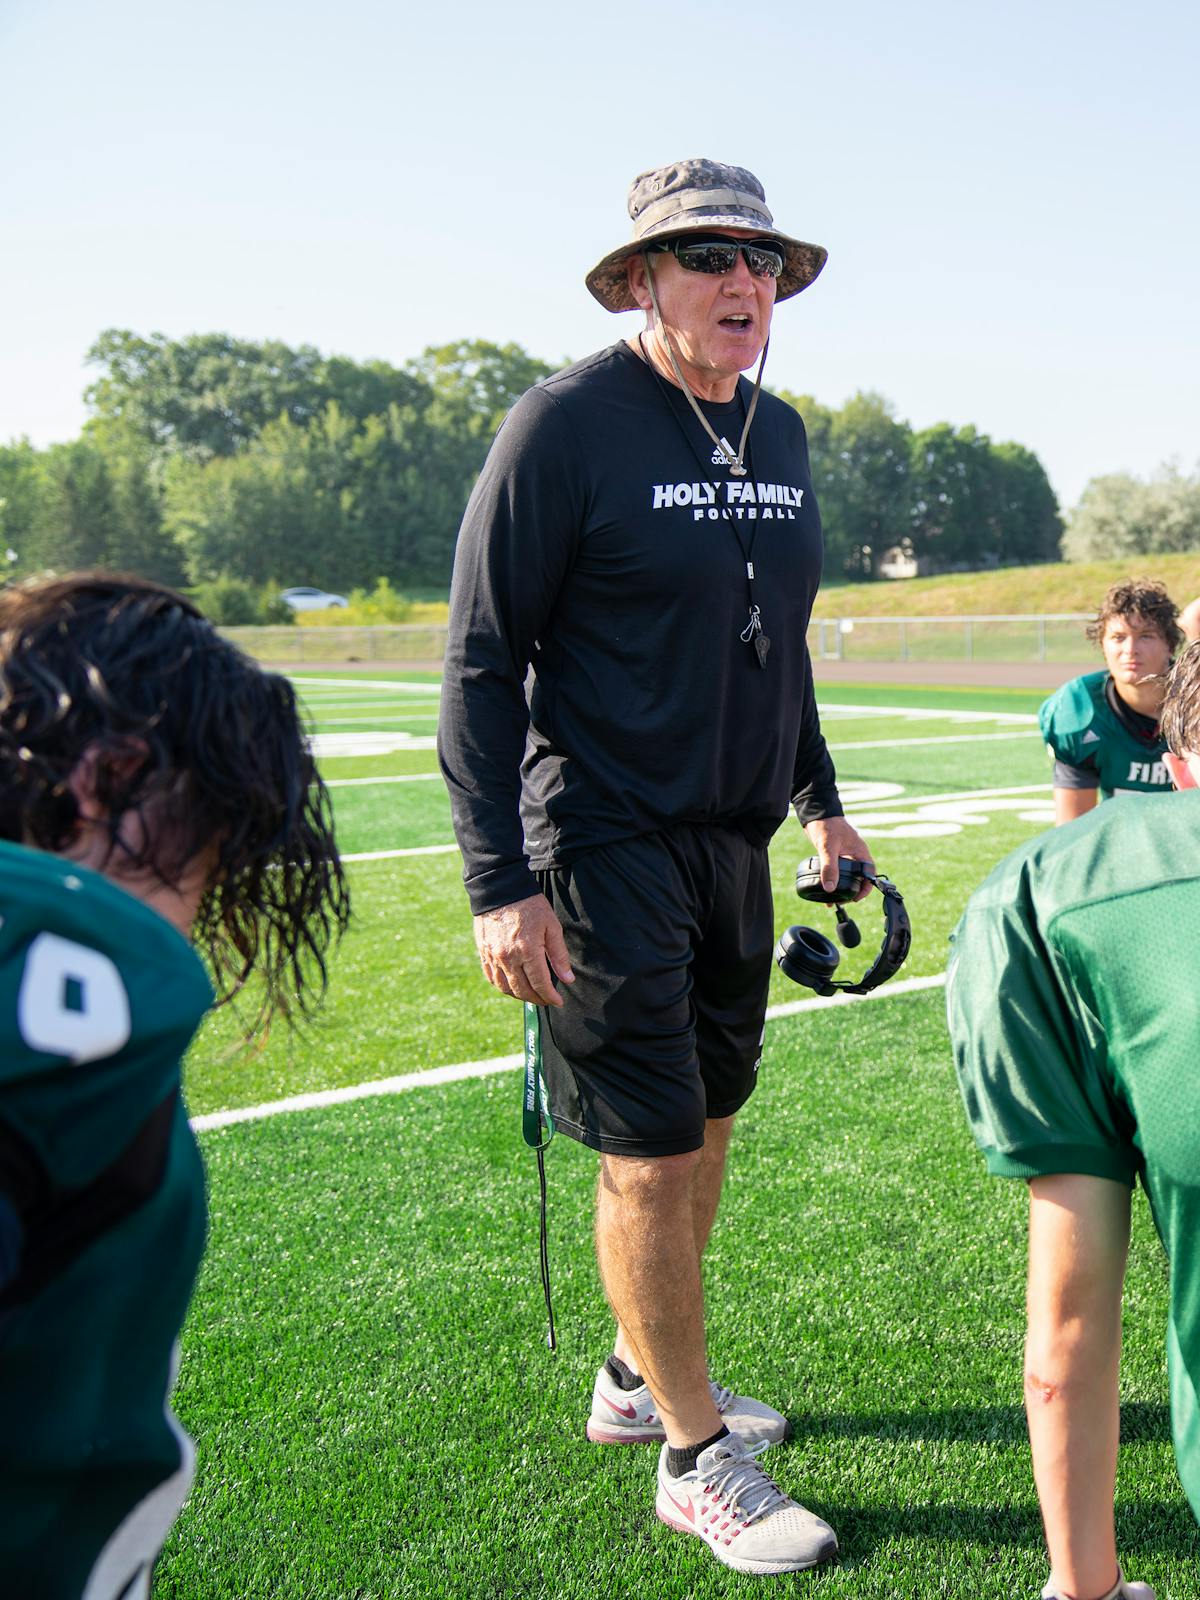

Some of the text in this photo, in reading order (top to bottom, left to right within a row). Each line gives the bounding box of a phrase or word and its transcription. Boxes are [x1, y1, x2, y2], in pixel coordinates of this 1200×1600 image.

[652, 482, 804, 509] HOLY FAMILY
[694, 507, 796, 521] FOOTBALL
[1127, 760, 1174, 785] FIR
